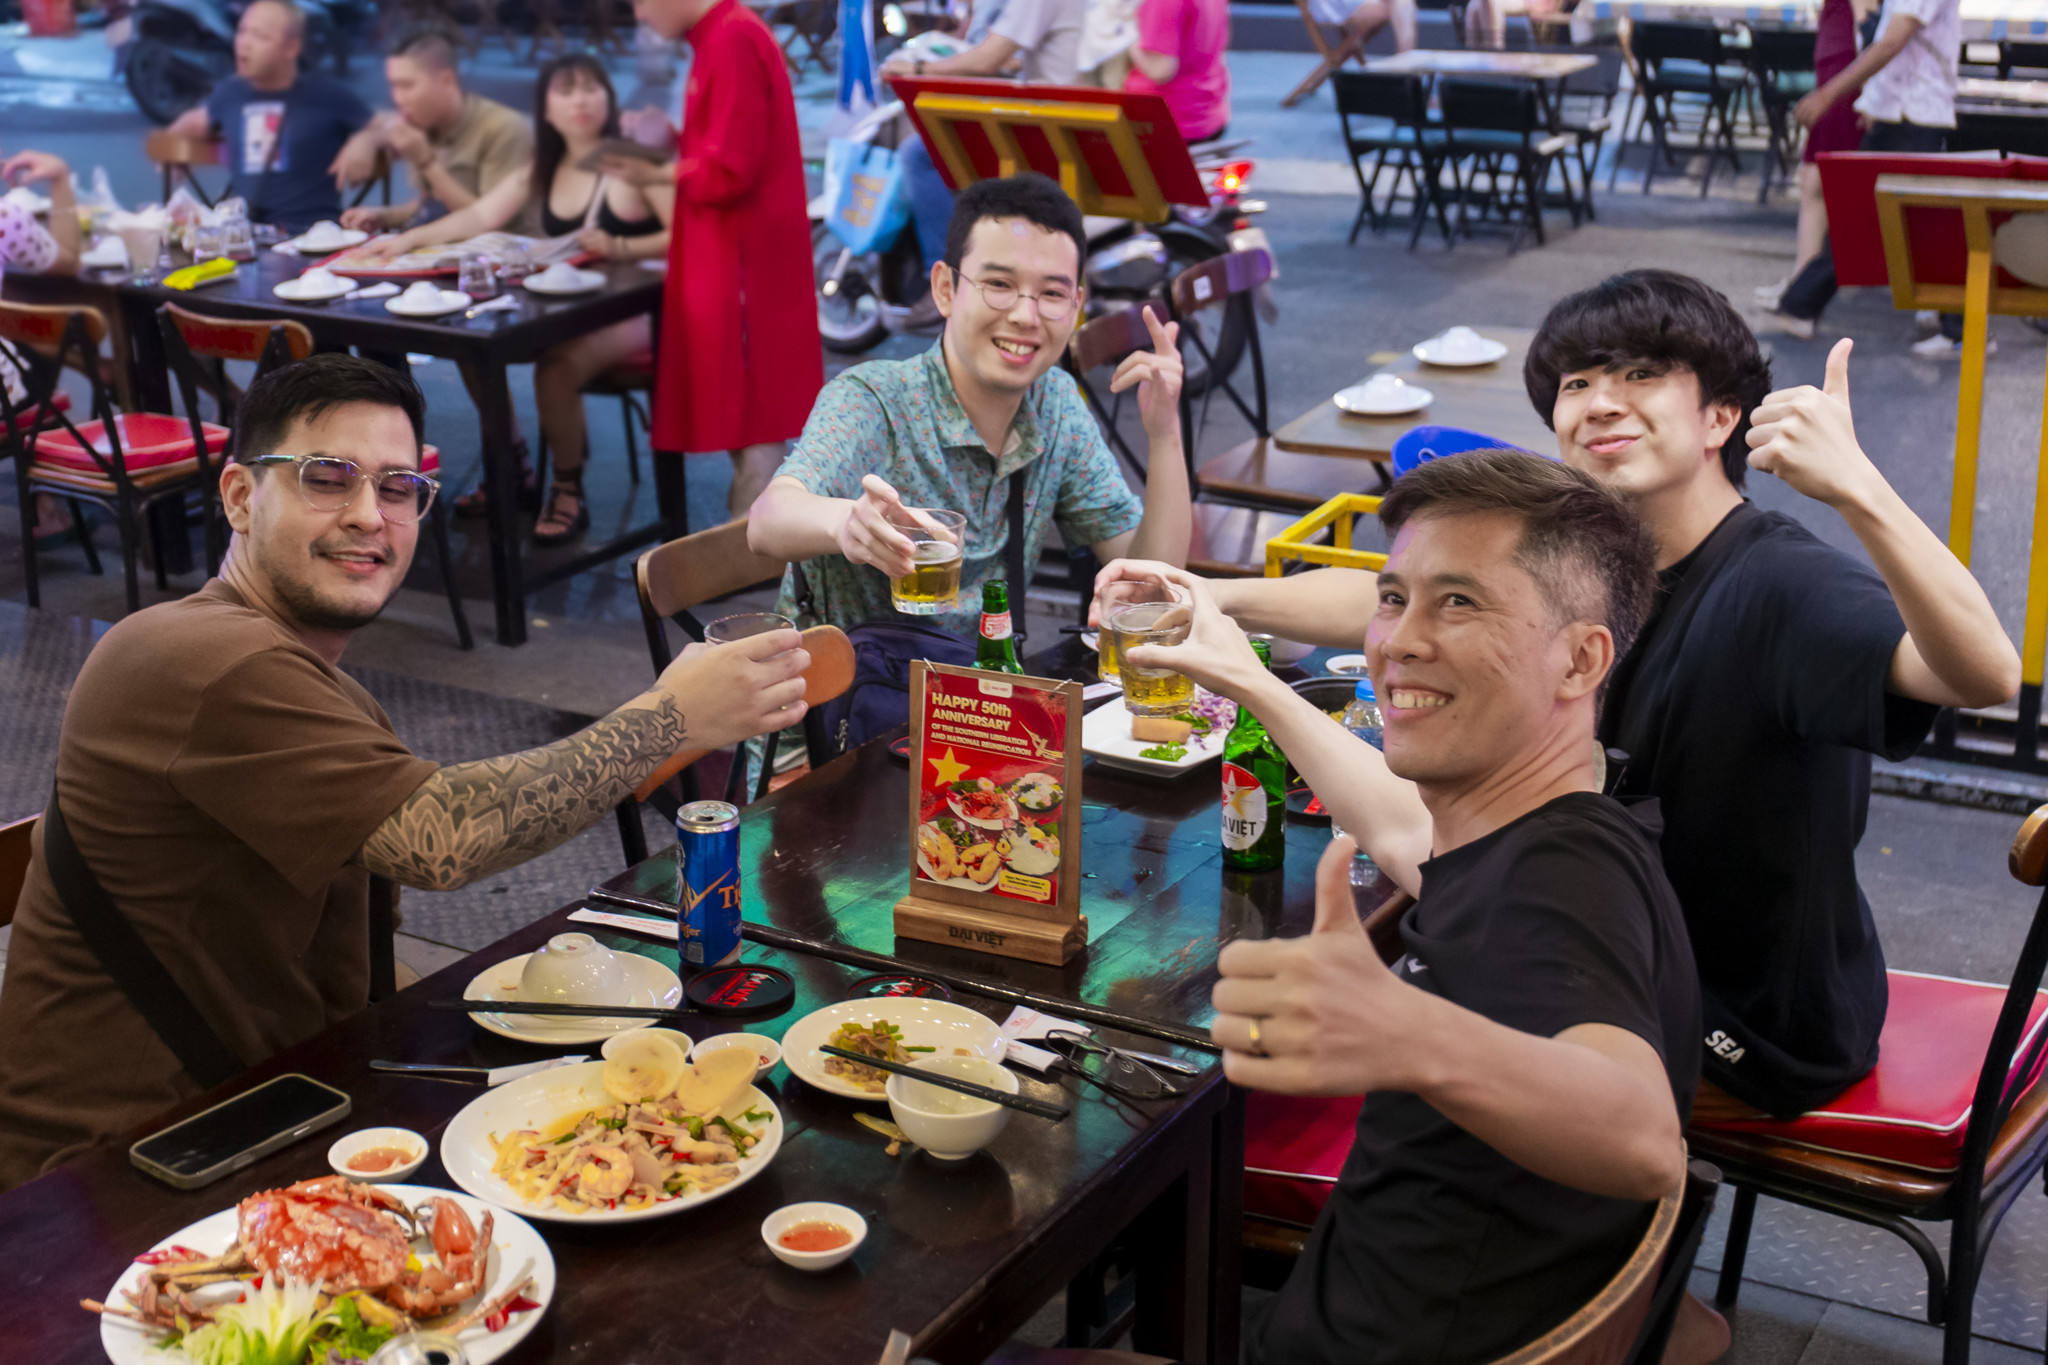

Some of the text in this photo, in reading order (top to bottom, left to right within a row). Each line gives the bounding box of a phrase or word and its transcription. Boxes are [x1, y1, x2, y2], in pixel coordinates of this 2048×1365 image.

[931, 692, 1012, 718] HAPPY 50th
[932, 708, 1012, 731] ANNIVERSARY
[930, 732, 1032, 756] AND NATIONAL REUNIFICATION
[931, 722, 1028, 746] OF THE SOUTHERN LIBERATION
[1228, 818, 1257, 837] VIỆT
[974, 930, 1006, 948] VIỆT
[1704, 1029, 1746, 1064] SEA
